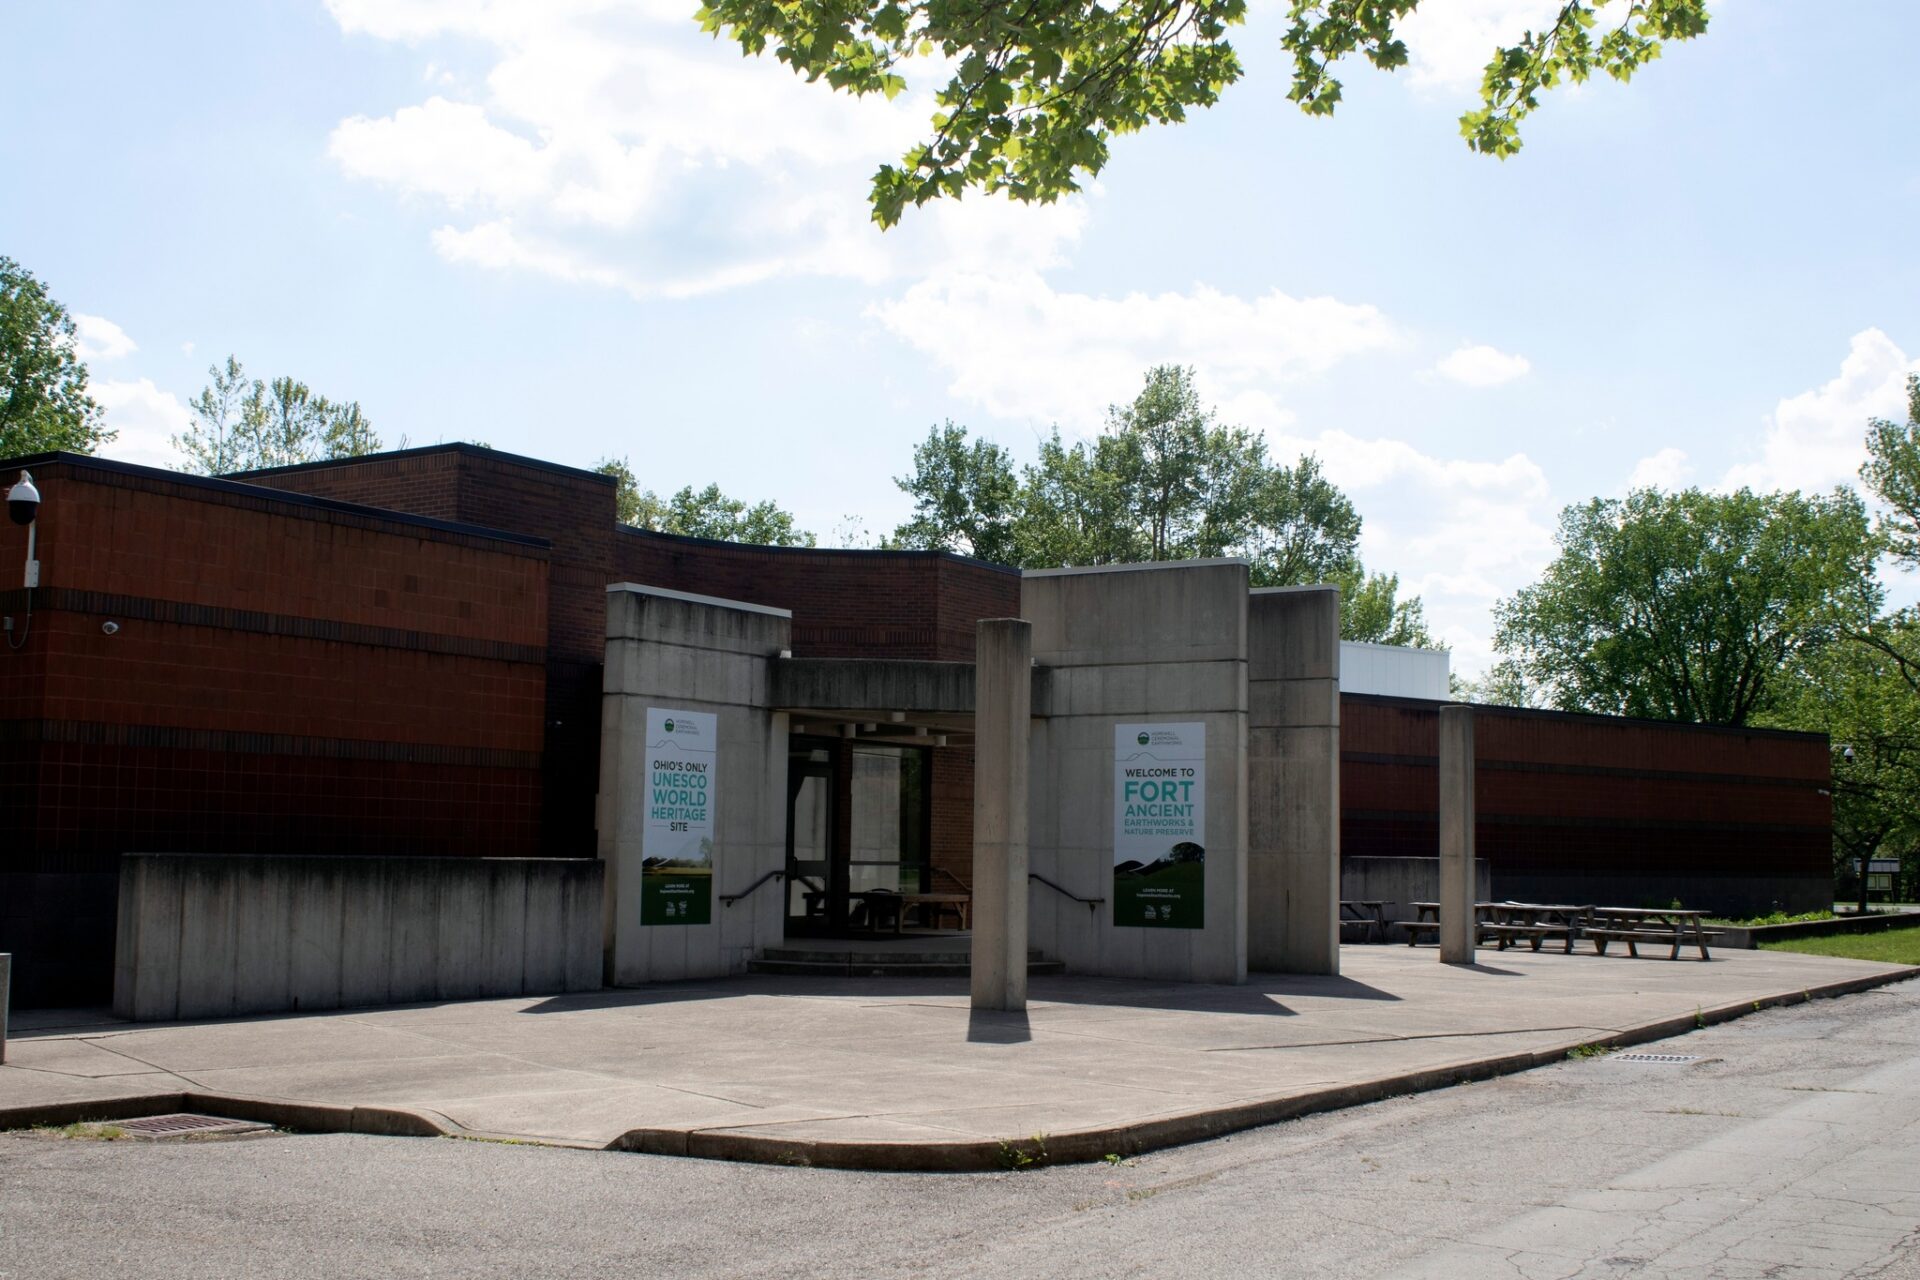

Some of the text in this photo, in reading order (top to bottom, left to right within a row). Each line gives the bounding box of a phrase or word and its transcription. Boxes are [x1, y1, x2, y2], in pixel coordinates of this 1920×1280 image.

[654, 760, 708, 773] OHIO'S ONLY
[1126, 768, 1195, 777] WELCOME TO
[653, 772, 707, 788] UNESCO
[653, 789, 706, 806] WORLD
[1125, 781, 1194, 802] FORT
[652, 807, 706, 820] HERITAGE
[1125, 804, 1194, 817] ANCIENT
[670, 821, 688, 832] SITE
[1124, 818, 1194, 827] EARTHWORKS &
[1124, 828, 1194, 836] NATURE PRESERVE
